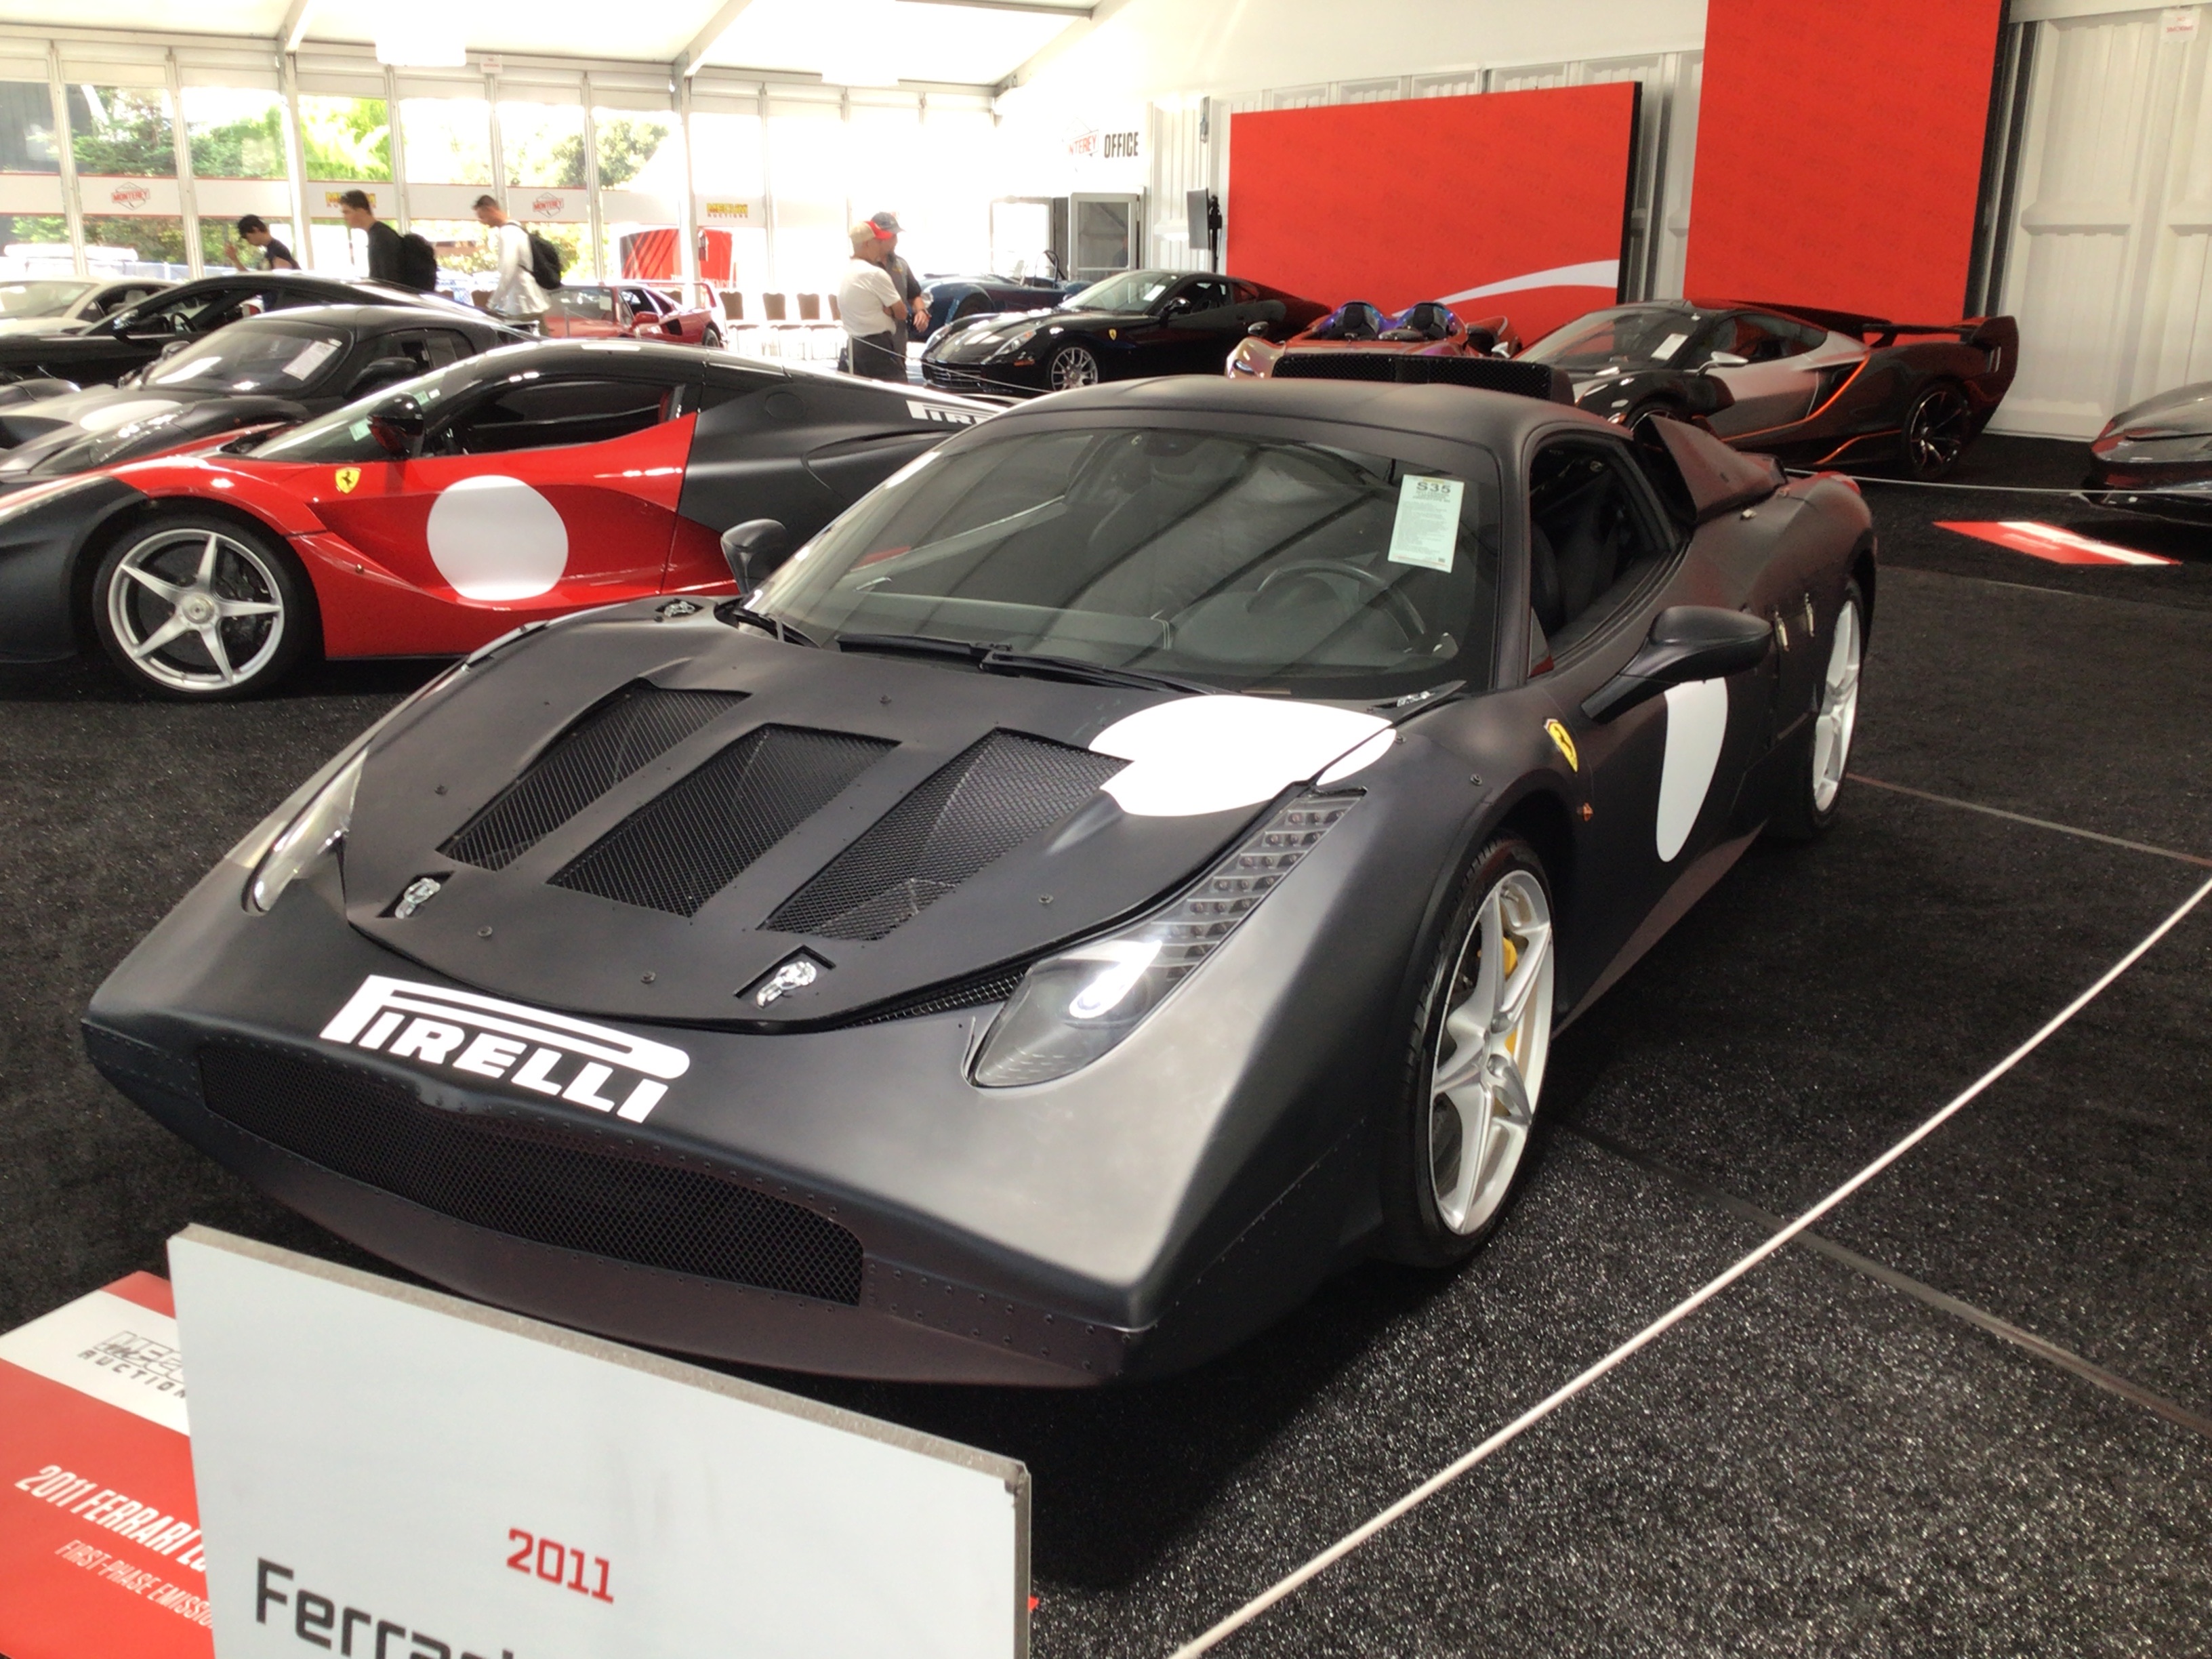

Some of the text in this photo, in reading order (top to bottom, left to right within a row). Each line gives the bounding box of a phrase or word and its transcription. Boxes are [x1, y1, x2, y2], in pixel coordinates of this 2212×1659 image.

[1104, 131, 1139, 159] OFFICE
[1416, 482, 1451, 493] S35
[319, 975, 690, 1123] PIRELLI
[14, 1465, 98, 1507] 2011
[70, 1489, 202, 1555] FERRARI
[54, 1539, 161, 1595] FIRST-PHASE
[506, 1527, 613, 1604] 2011
